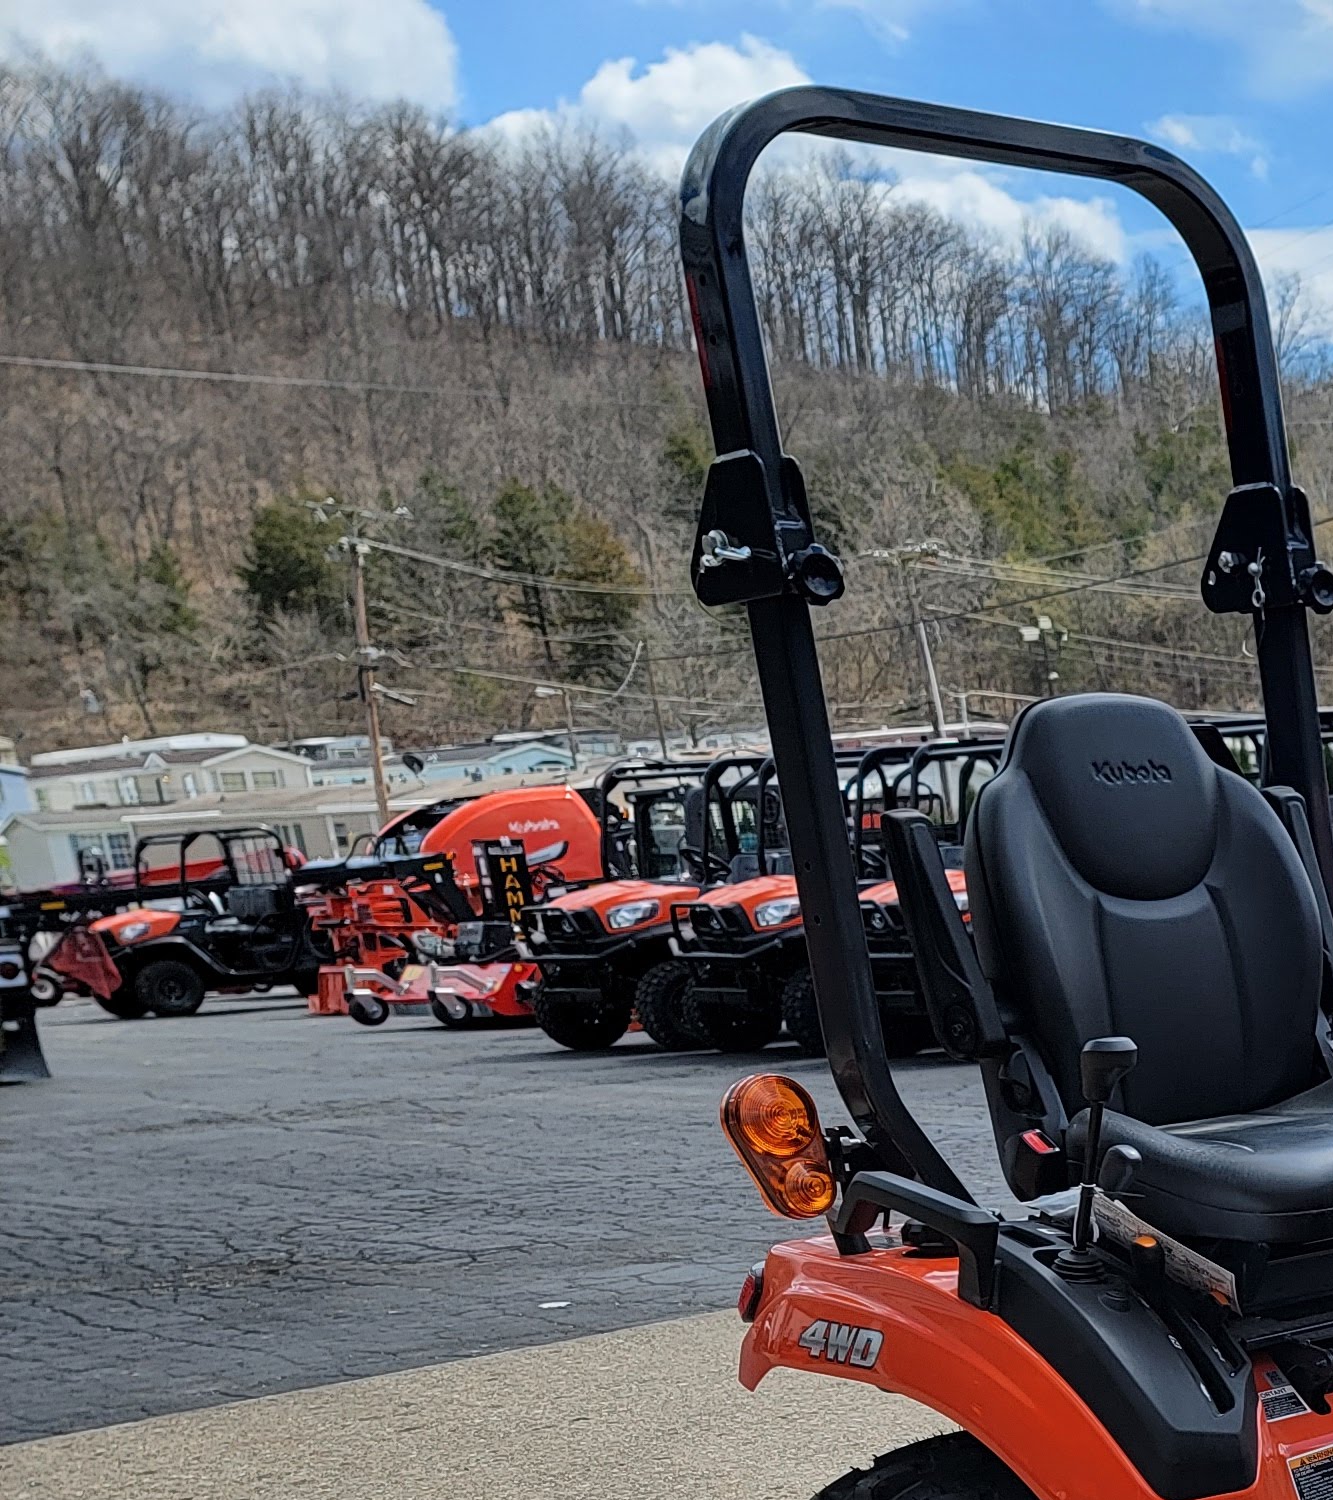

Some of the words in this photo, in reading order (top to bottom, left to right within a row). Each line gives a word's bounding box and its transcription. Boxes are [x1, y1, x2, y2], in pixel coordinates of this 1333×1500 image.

[1090, 758, 1172, 785] Kubota
[797, 1318, 884, 1369] 4WD
[1260, 1387, 1287, 1399] ORTANT
